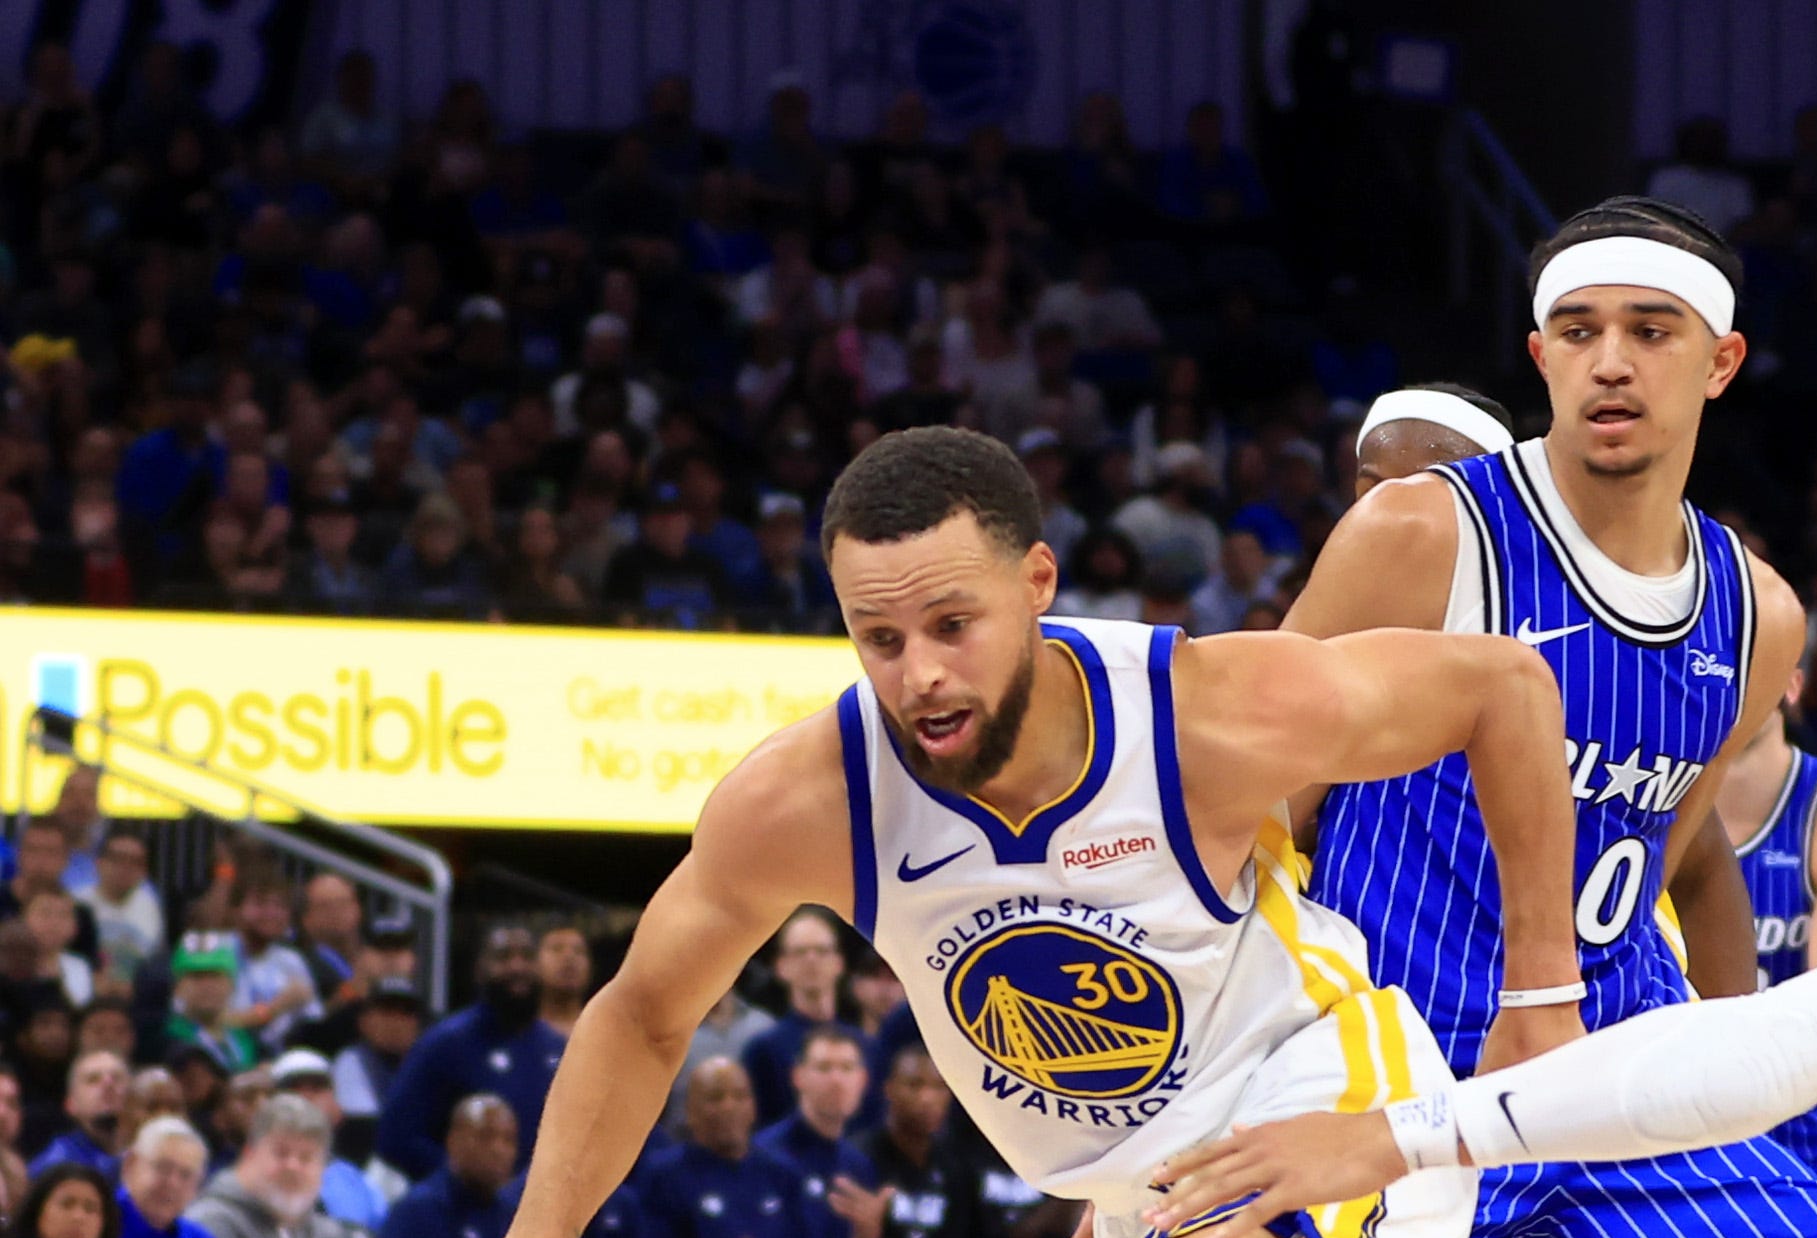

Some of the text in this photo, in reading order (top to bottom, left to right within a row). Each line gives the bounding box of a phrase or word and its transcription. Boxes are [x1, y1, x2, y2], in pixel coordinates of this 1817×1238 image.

[97, 657, 508, 777] Possible
[651, 688, 753, 724] cash
[1062, 836, 1156, 869] Rakuten
[1574, 836, 1649, 945] 0
[926, 895, 1149, 972] GOLDEN STATE
[1754, 914, 1811, 952] DO
[1060, 959, 1147, 1010] 30
